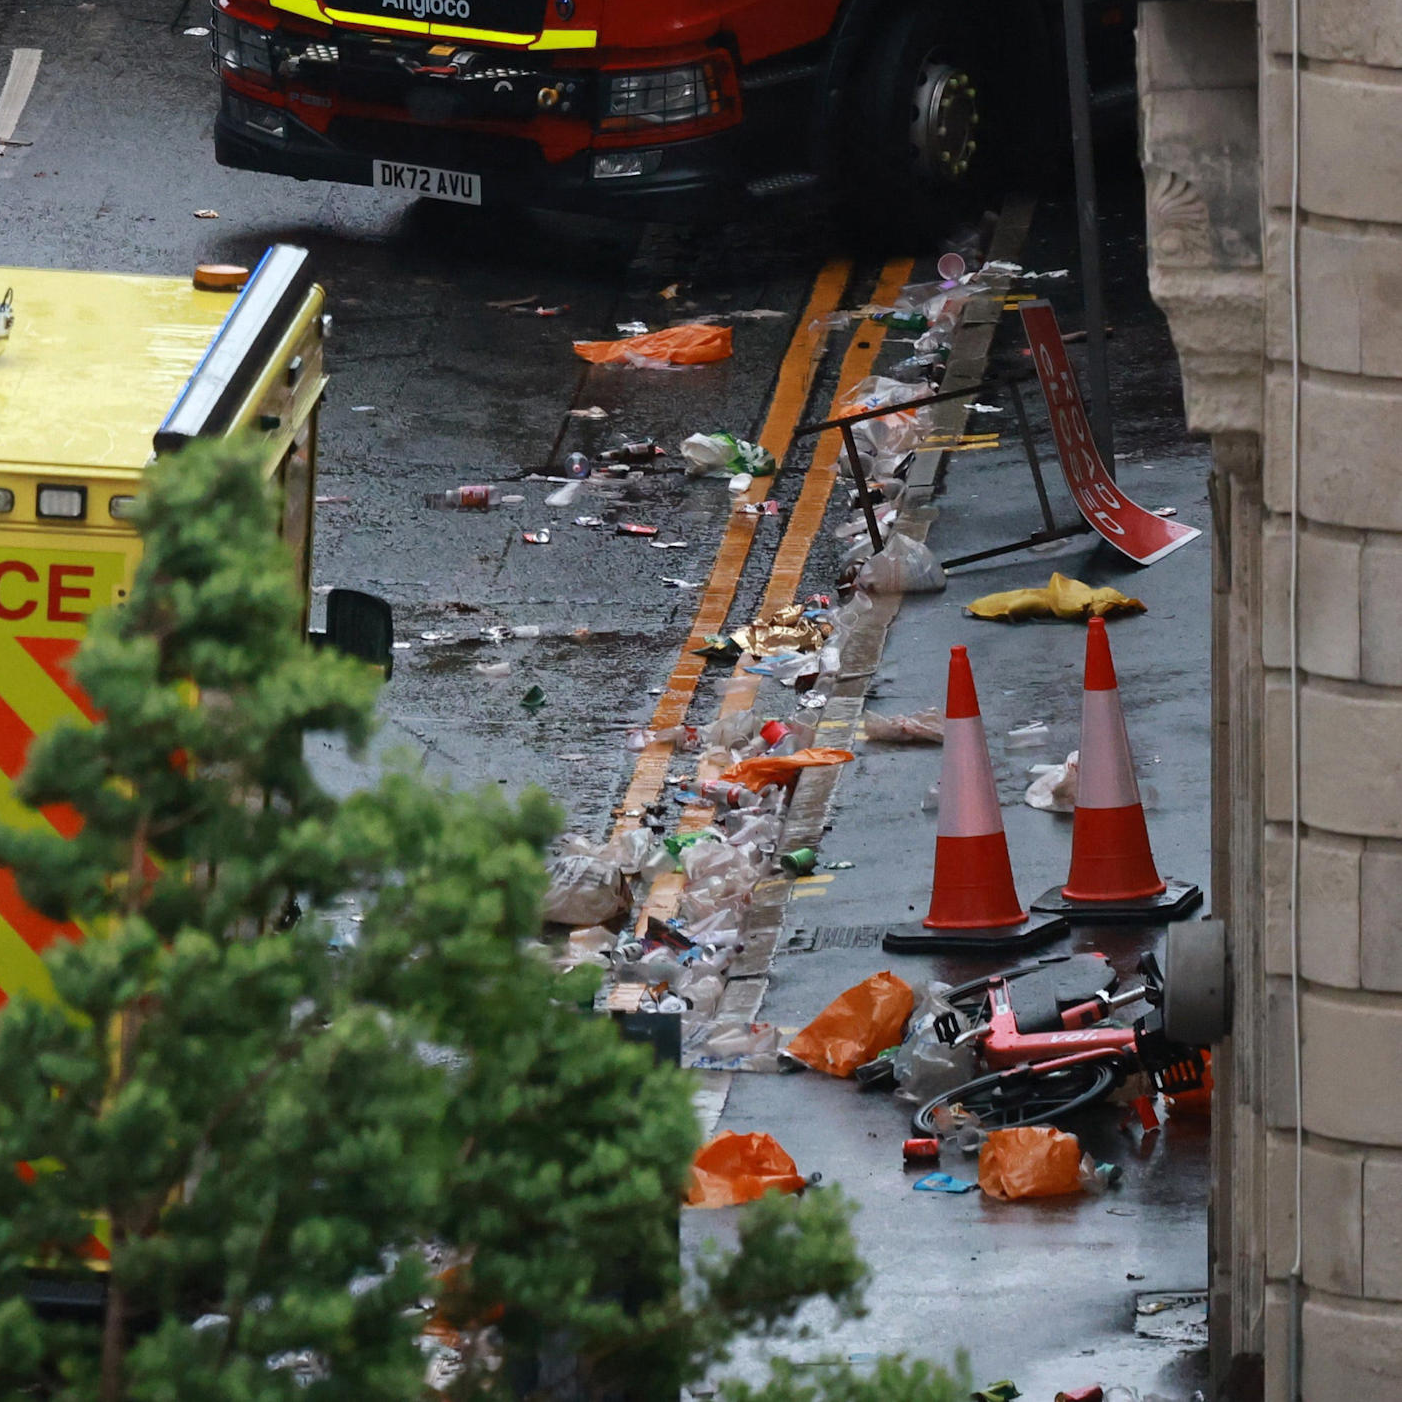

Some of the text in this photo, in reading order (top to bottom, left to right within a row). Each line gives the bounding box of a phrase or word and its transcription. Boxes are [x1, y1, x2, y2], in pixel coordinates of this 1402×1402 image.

[381, 163, 473, 198] DK72 AVU
[1039, 343, 1125, 536] CLOSED
[1061, 371, 1121, 510] ROAD
